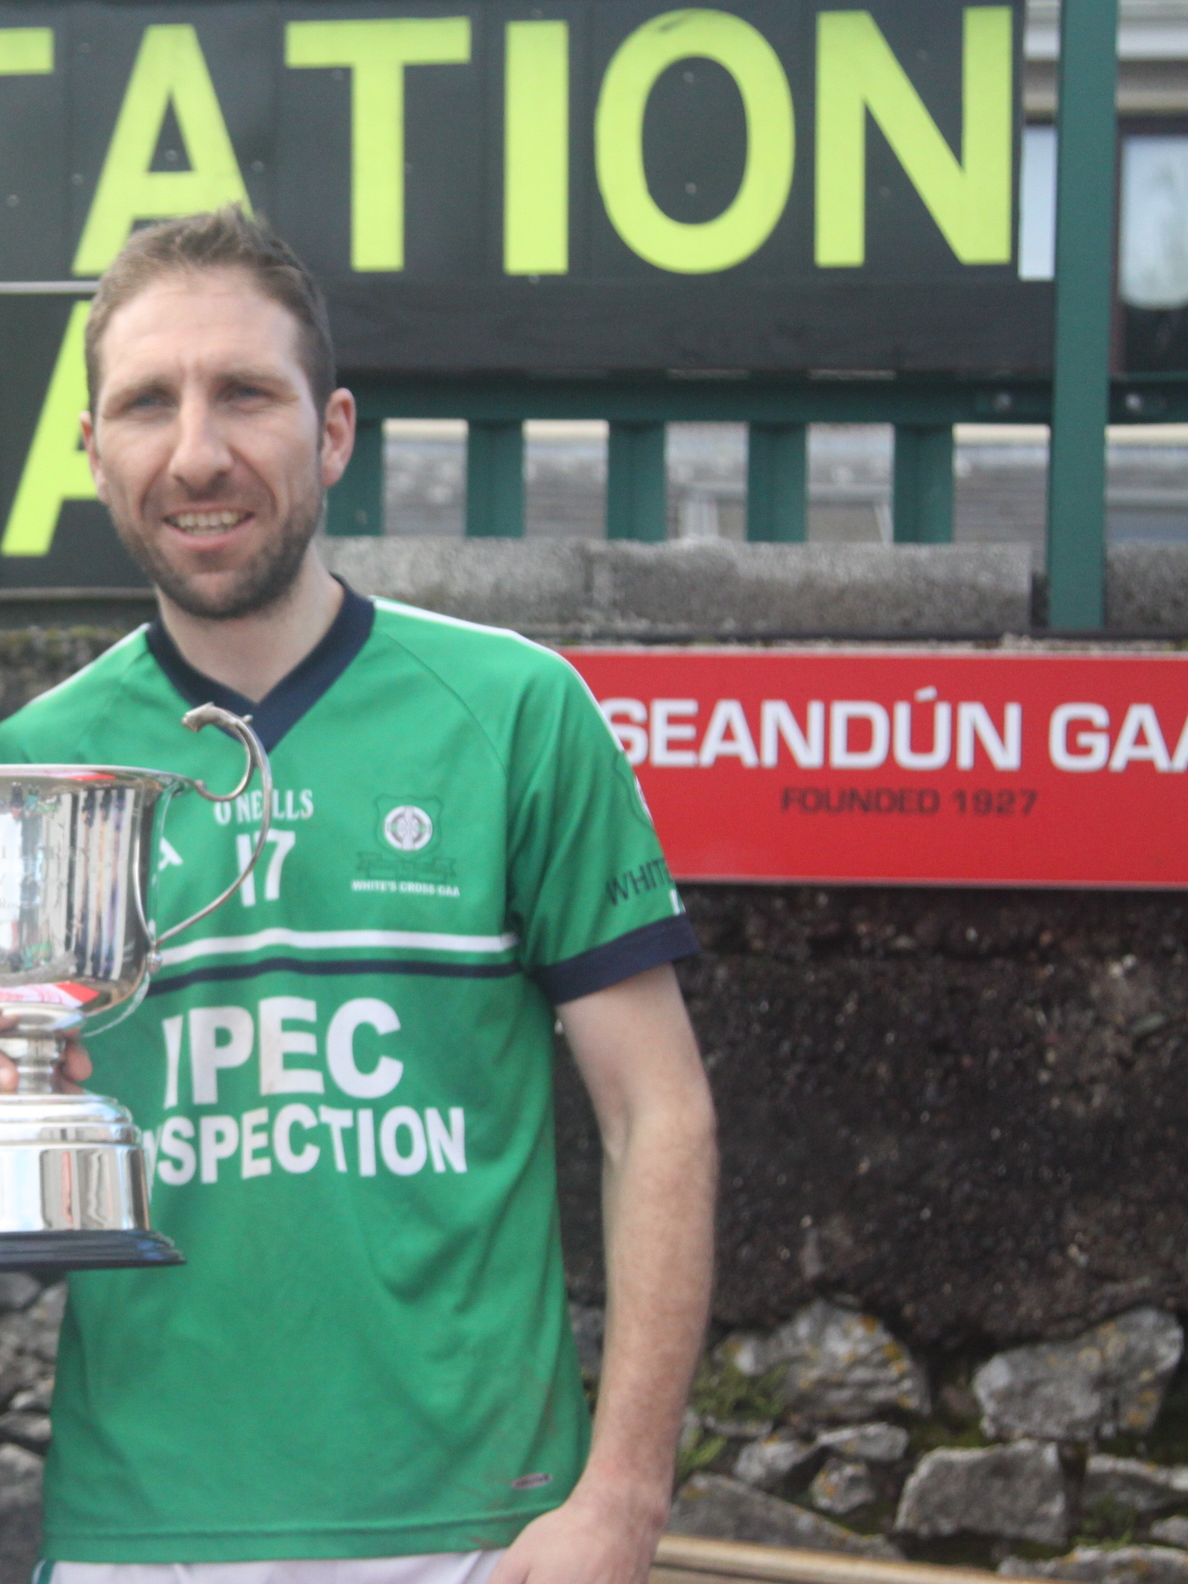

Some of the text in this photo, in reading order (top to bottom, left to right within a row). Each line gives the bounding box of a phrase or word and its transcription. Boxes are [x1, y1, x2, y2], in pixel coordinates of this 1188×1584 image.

[601, 686, 1021, 771] SEANDÚN
[782, 786, 1039, 817] FOUNDED 1927
[236, 828, 296, 908] 17
[351, 879, 461, 898] WHITE'S CROSS GAA
